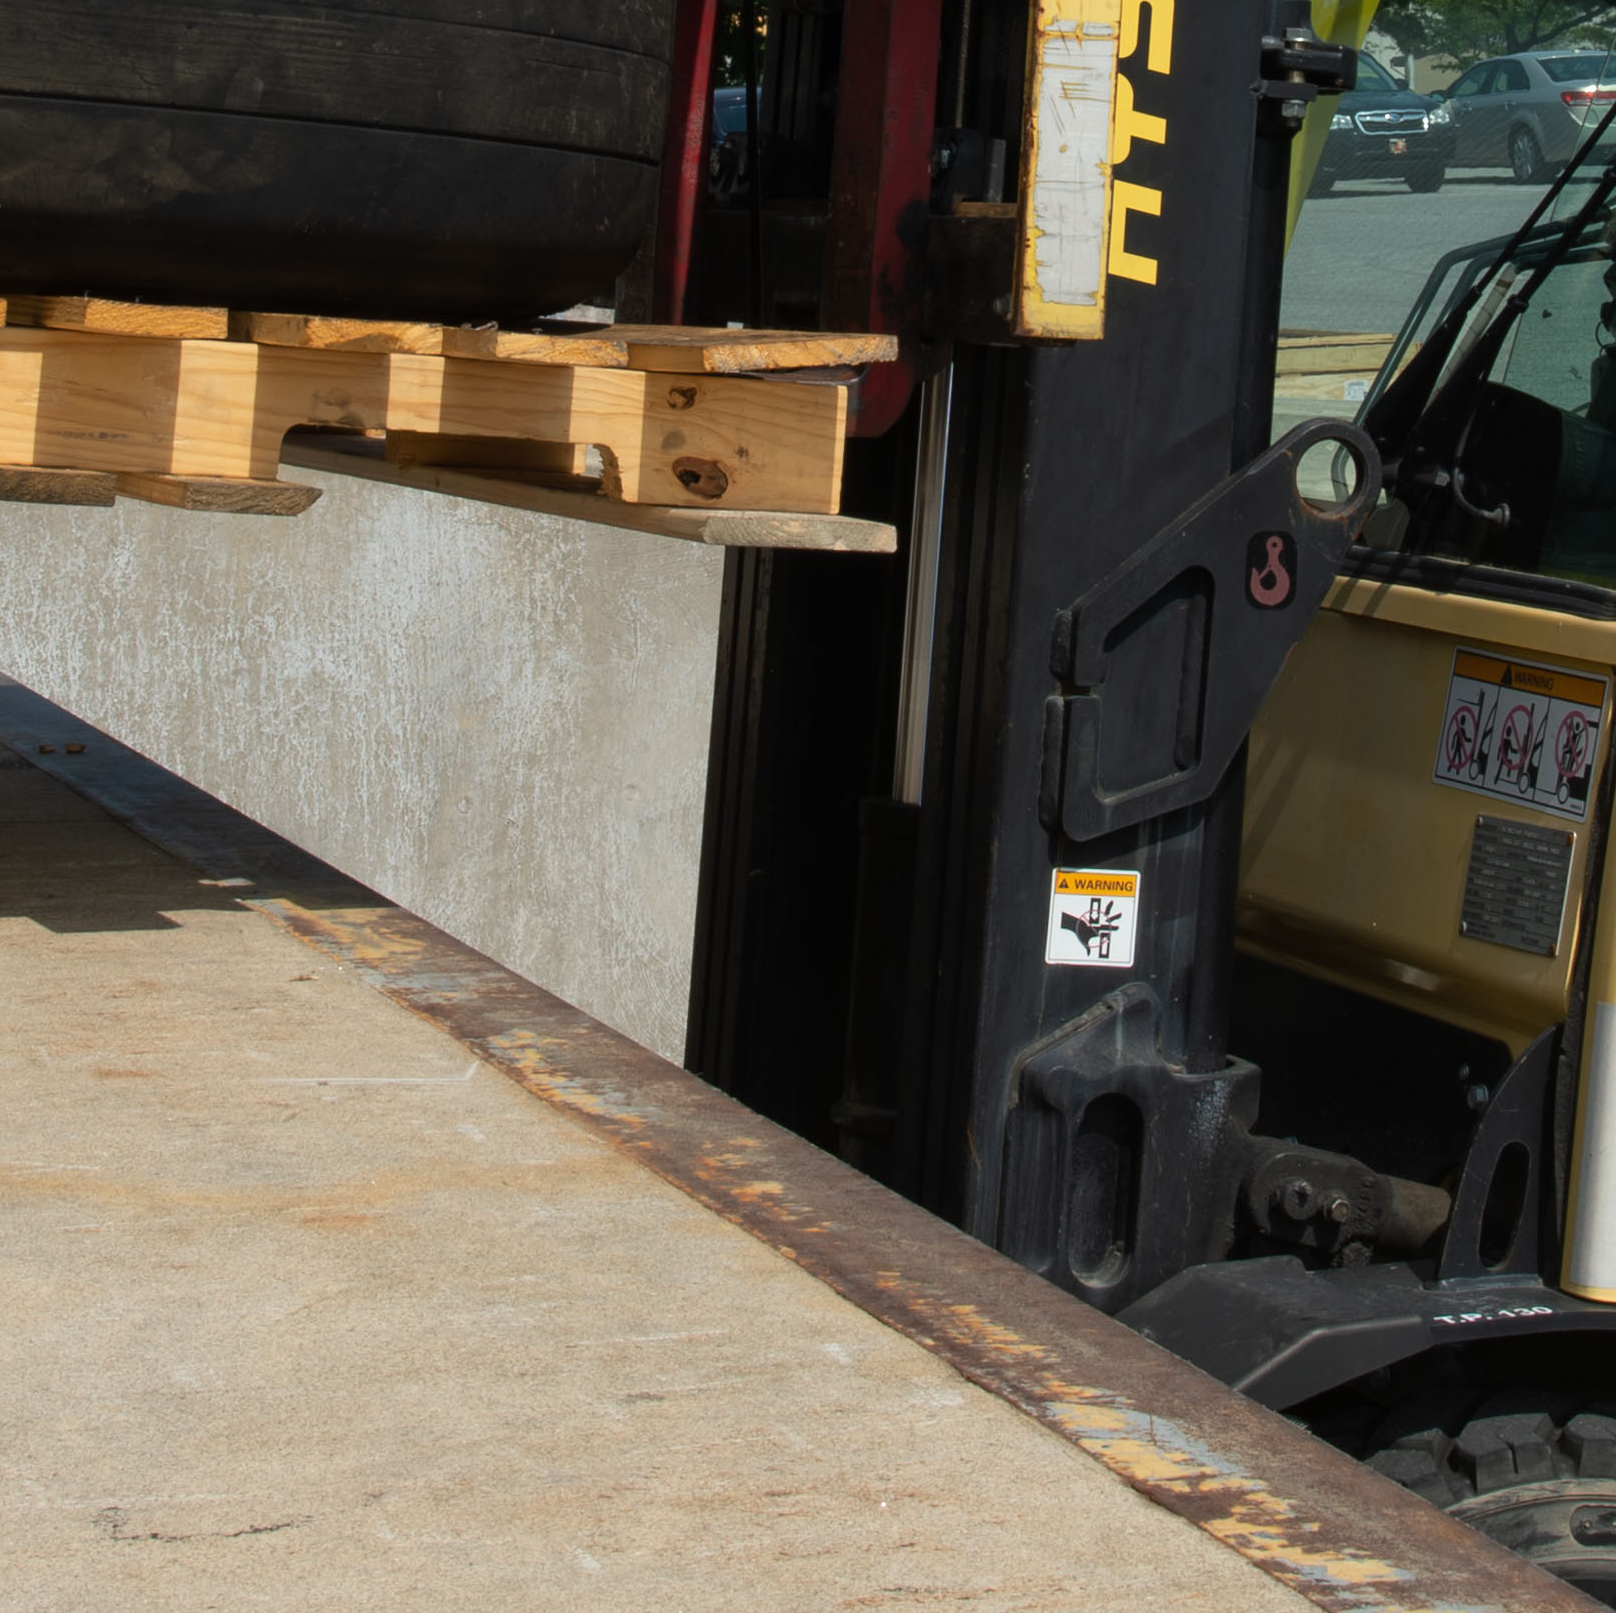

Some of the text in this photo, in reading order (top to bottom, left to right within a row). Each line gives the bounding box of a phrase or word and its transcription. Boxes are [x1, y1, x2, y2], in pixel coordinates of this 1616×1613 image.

[1515, 672, 1554, 691] WARNING
[1075, 879, 1133, 892] WARNING
[1498, 1307, 1553, 1318] 130
